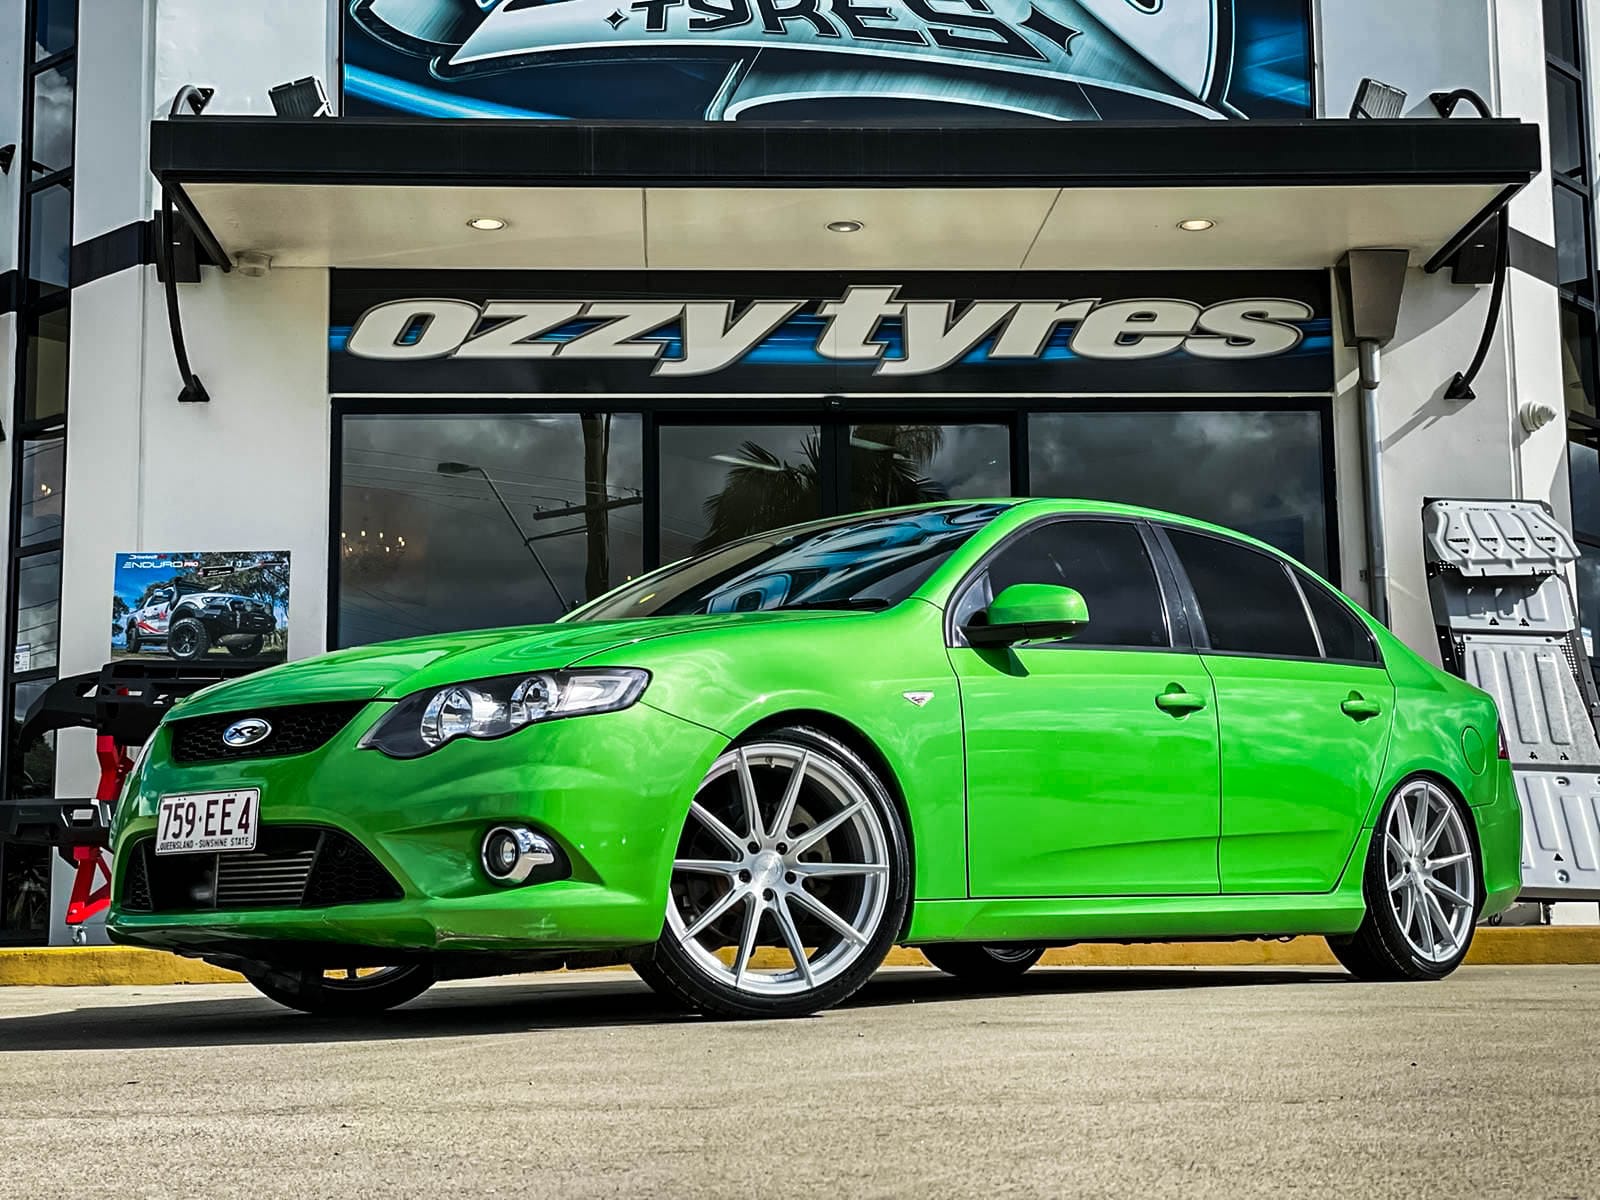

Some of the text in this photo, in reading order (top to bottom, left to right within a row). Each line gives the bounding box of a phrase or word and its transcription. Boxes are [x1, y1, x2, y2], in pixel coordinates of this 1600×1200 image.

[345, 284, 1315, 377] ozzy tyres
[122, 561, 183, 569] ENDURO
[159, 840, 194, 851] QUEENSLAND
[199, 838, 228, 849] SUNSHINE
[230, 837, 249, 847] STATE
